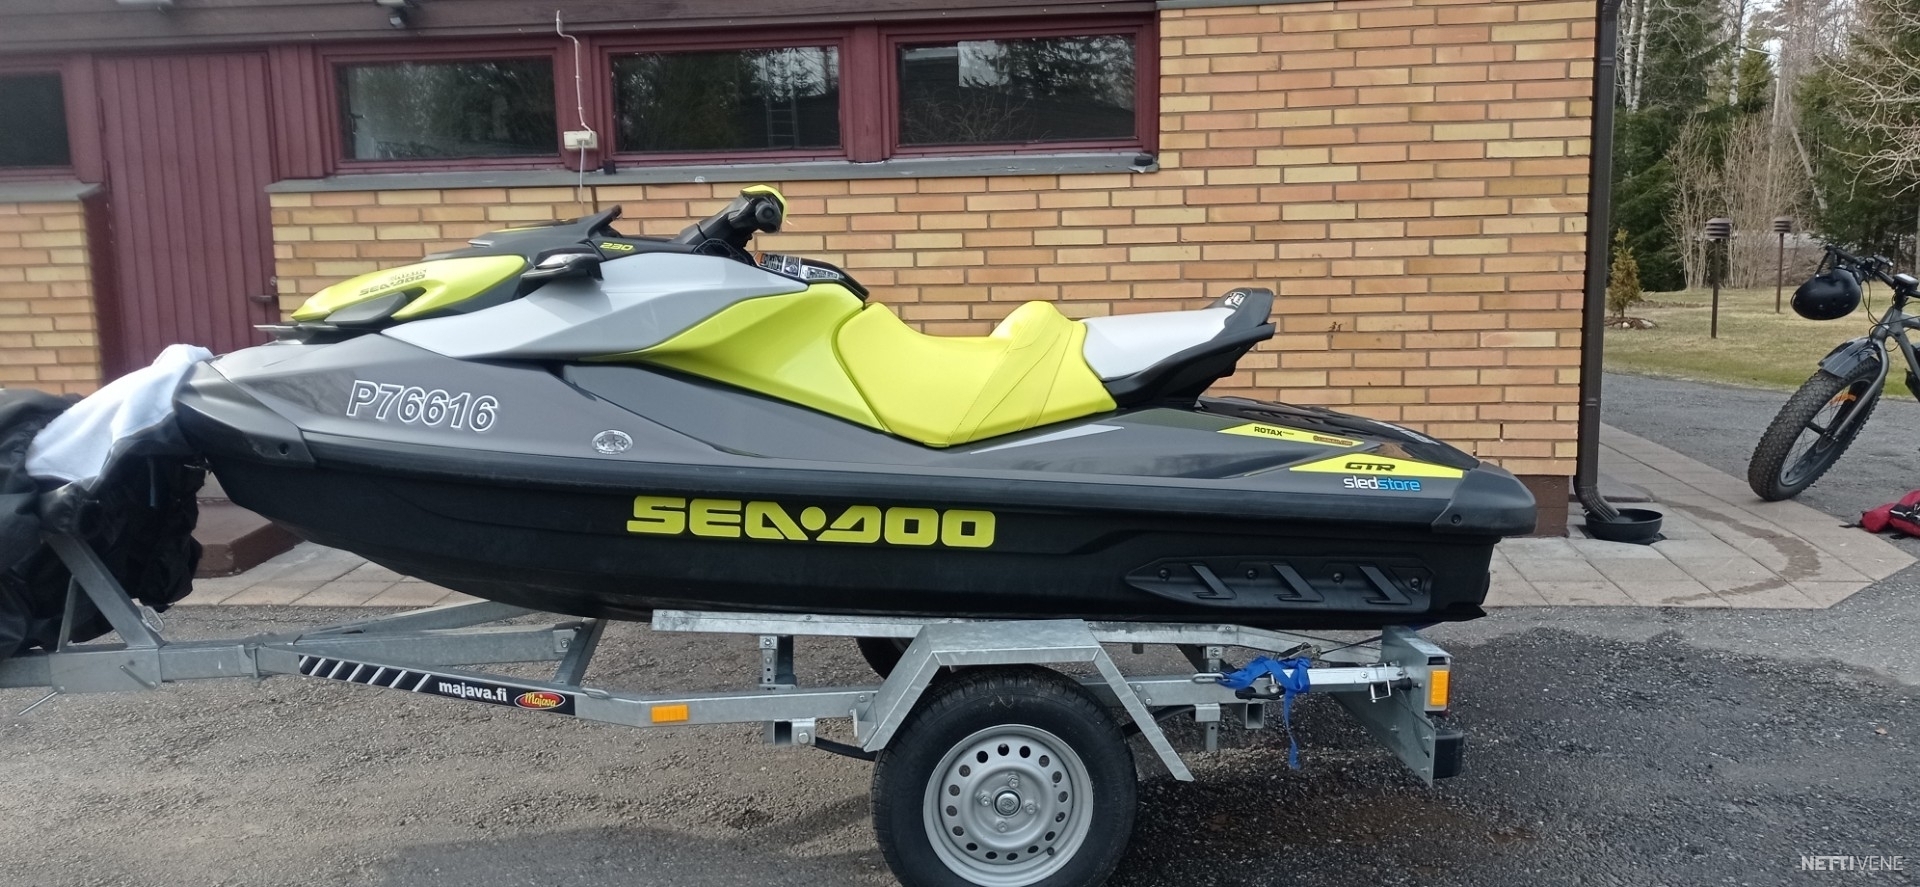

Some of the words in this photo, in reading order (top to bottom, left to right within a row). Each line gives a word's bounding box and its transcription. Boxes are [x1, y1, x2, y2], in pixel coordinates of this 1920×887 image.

[600, 242, 634, 251] 230
[346, 379, 499, 432] P76616
[1254, 426, 1283, 437] ROTAX
[1345, 462, 1396, 471] GTR
[1343, 475, 1421, 491] sledstore
[438, 682, 508, 702] majava.fi
